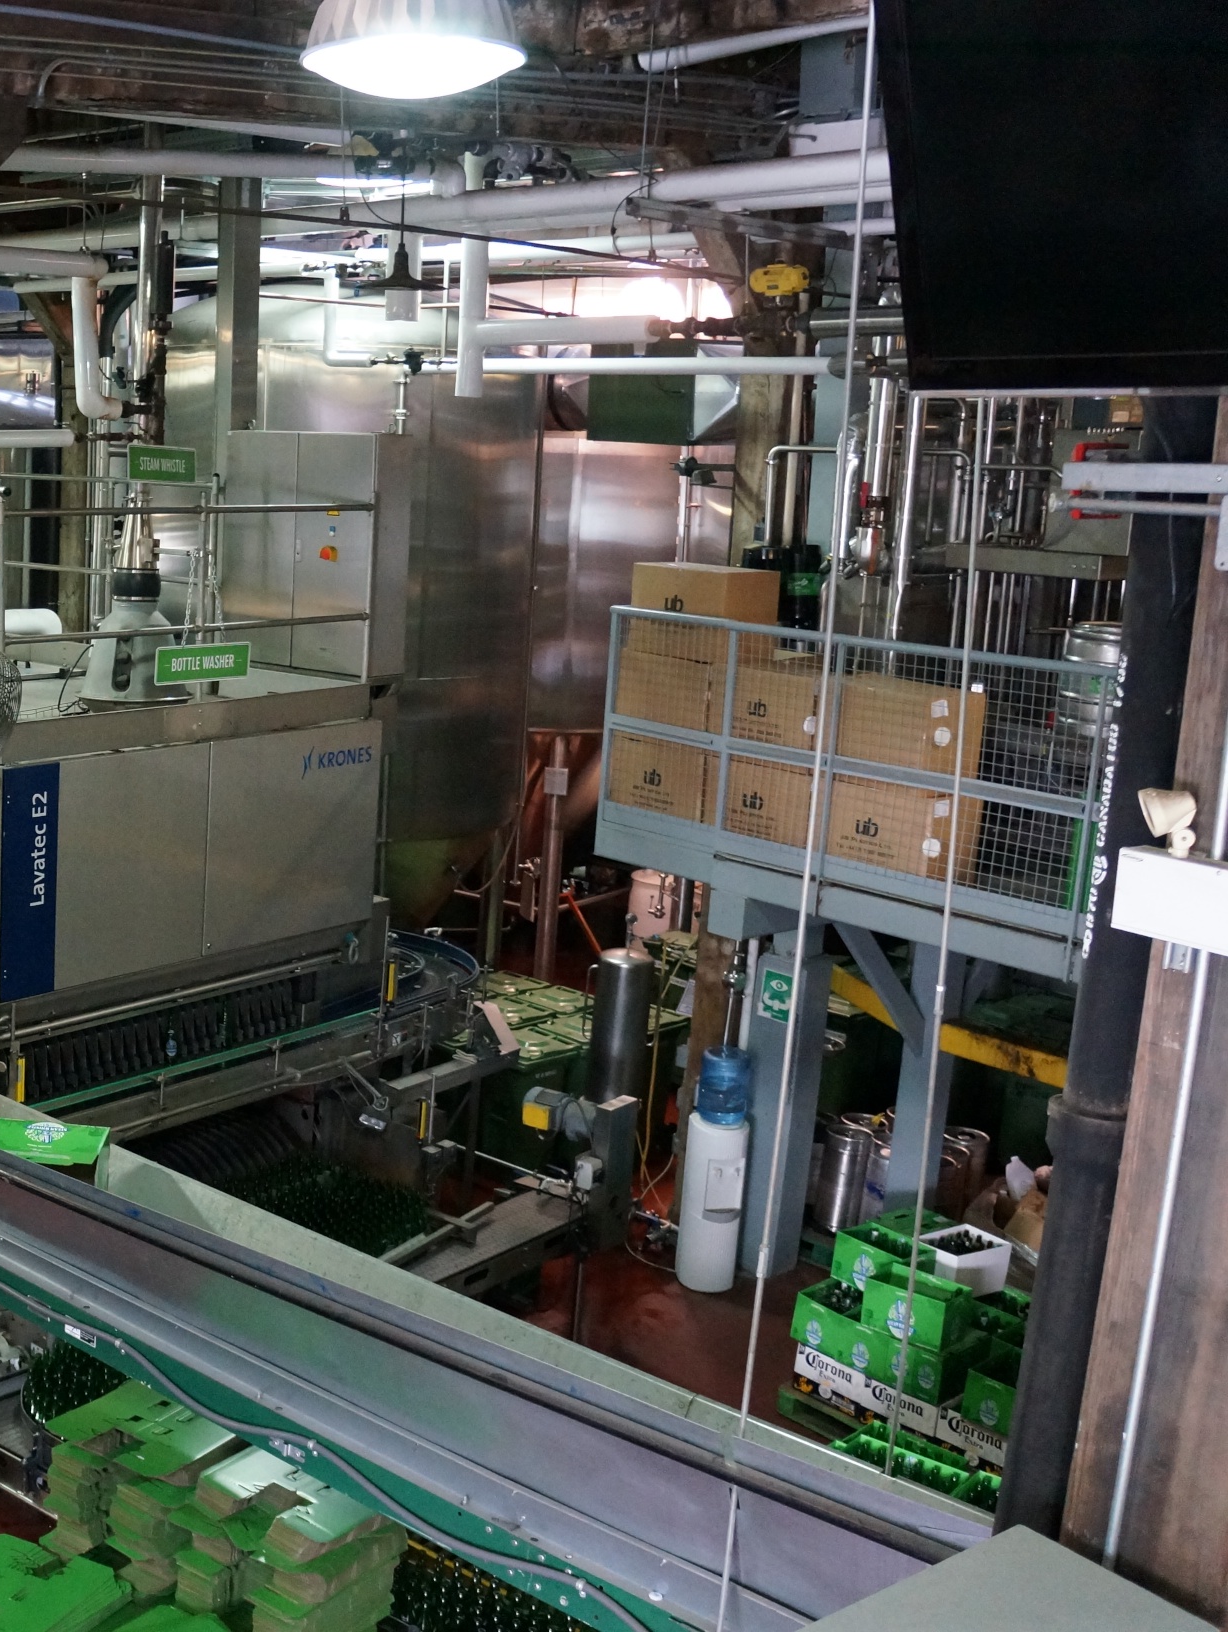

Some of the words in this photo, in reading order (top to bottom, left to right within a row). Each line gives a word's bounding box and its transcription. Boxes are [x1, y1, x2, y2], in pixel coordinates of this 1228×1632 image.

[139, 456, 160, 471] STEAM
[161, 458, 186, 474] WHISTLE
[171, 656, 201, 672] BOTTLE
[202, 654, 235, 670] WASHER
[317, 745, 372, 770] KRONES
[32, 791, 48, 818] E2
[29, 823, 47, 907] Lavatec
[805, 1351, 852, 1386] Corona
[947, 1416, 1004, 1453] Corona
